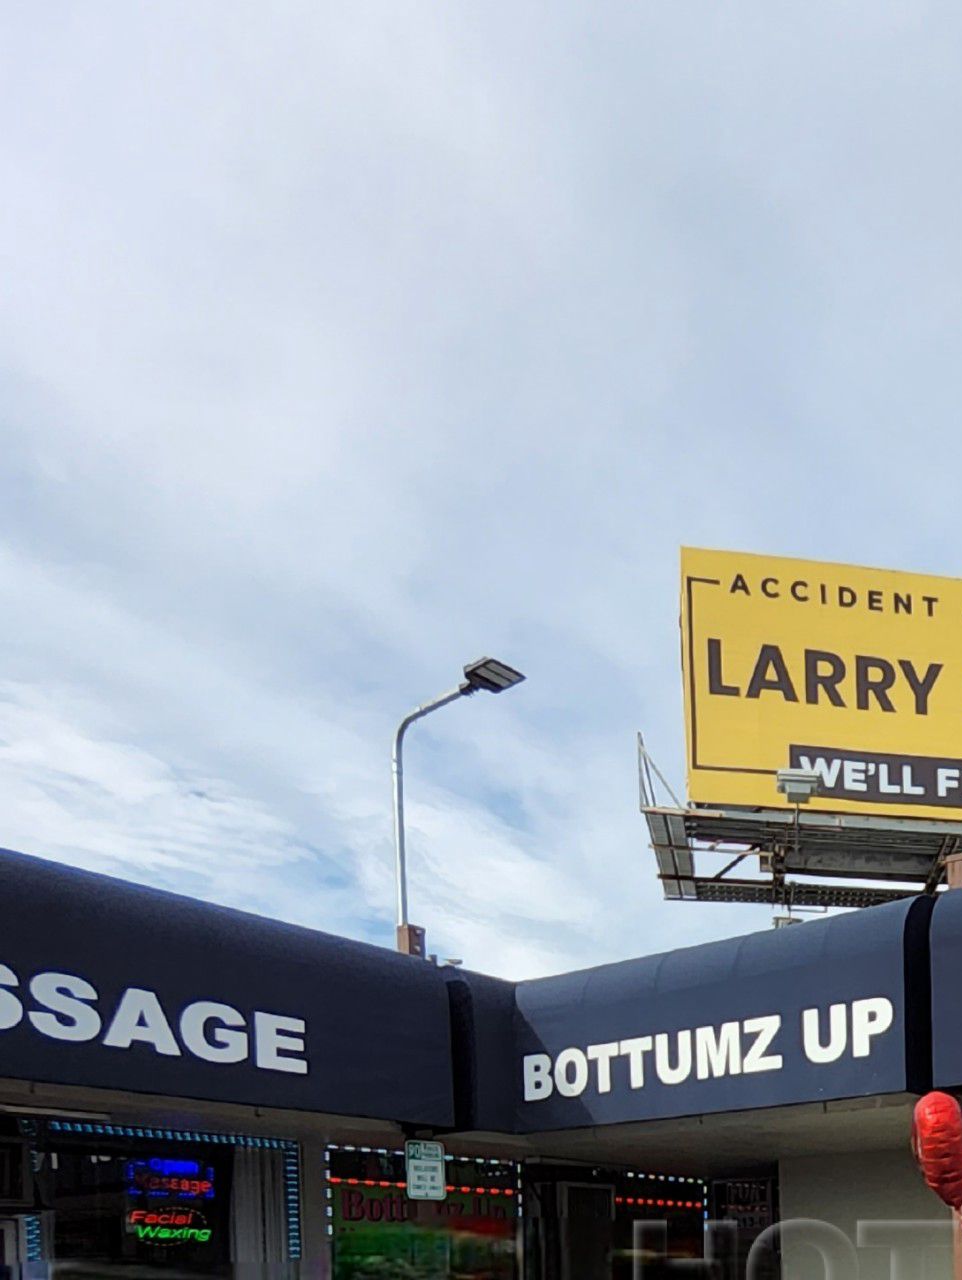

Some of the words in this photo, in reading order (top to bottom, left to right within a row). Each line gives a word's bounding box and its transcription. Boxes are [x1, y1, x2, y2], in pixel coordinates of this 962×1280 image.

[730, 574, 938, 617] ACCIDENT
[707, 638, 943, 716] LARRY
[799, 756, 924, 795] WE'LL
[523, 1015, 783, 1102] BOTTUMZ
[803, 997, 893, 1064] UP
[130, 1209, 193, 1225] Facial
[135, 1225, 212, 1242] Waxing
